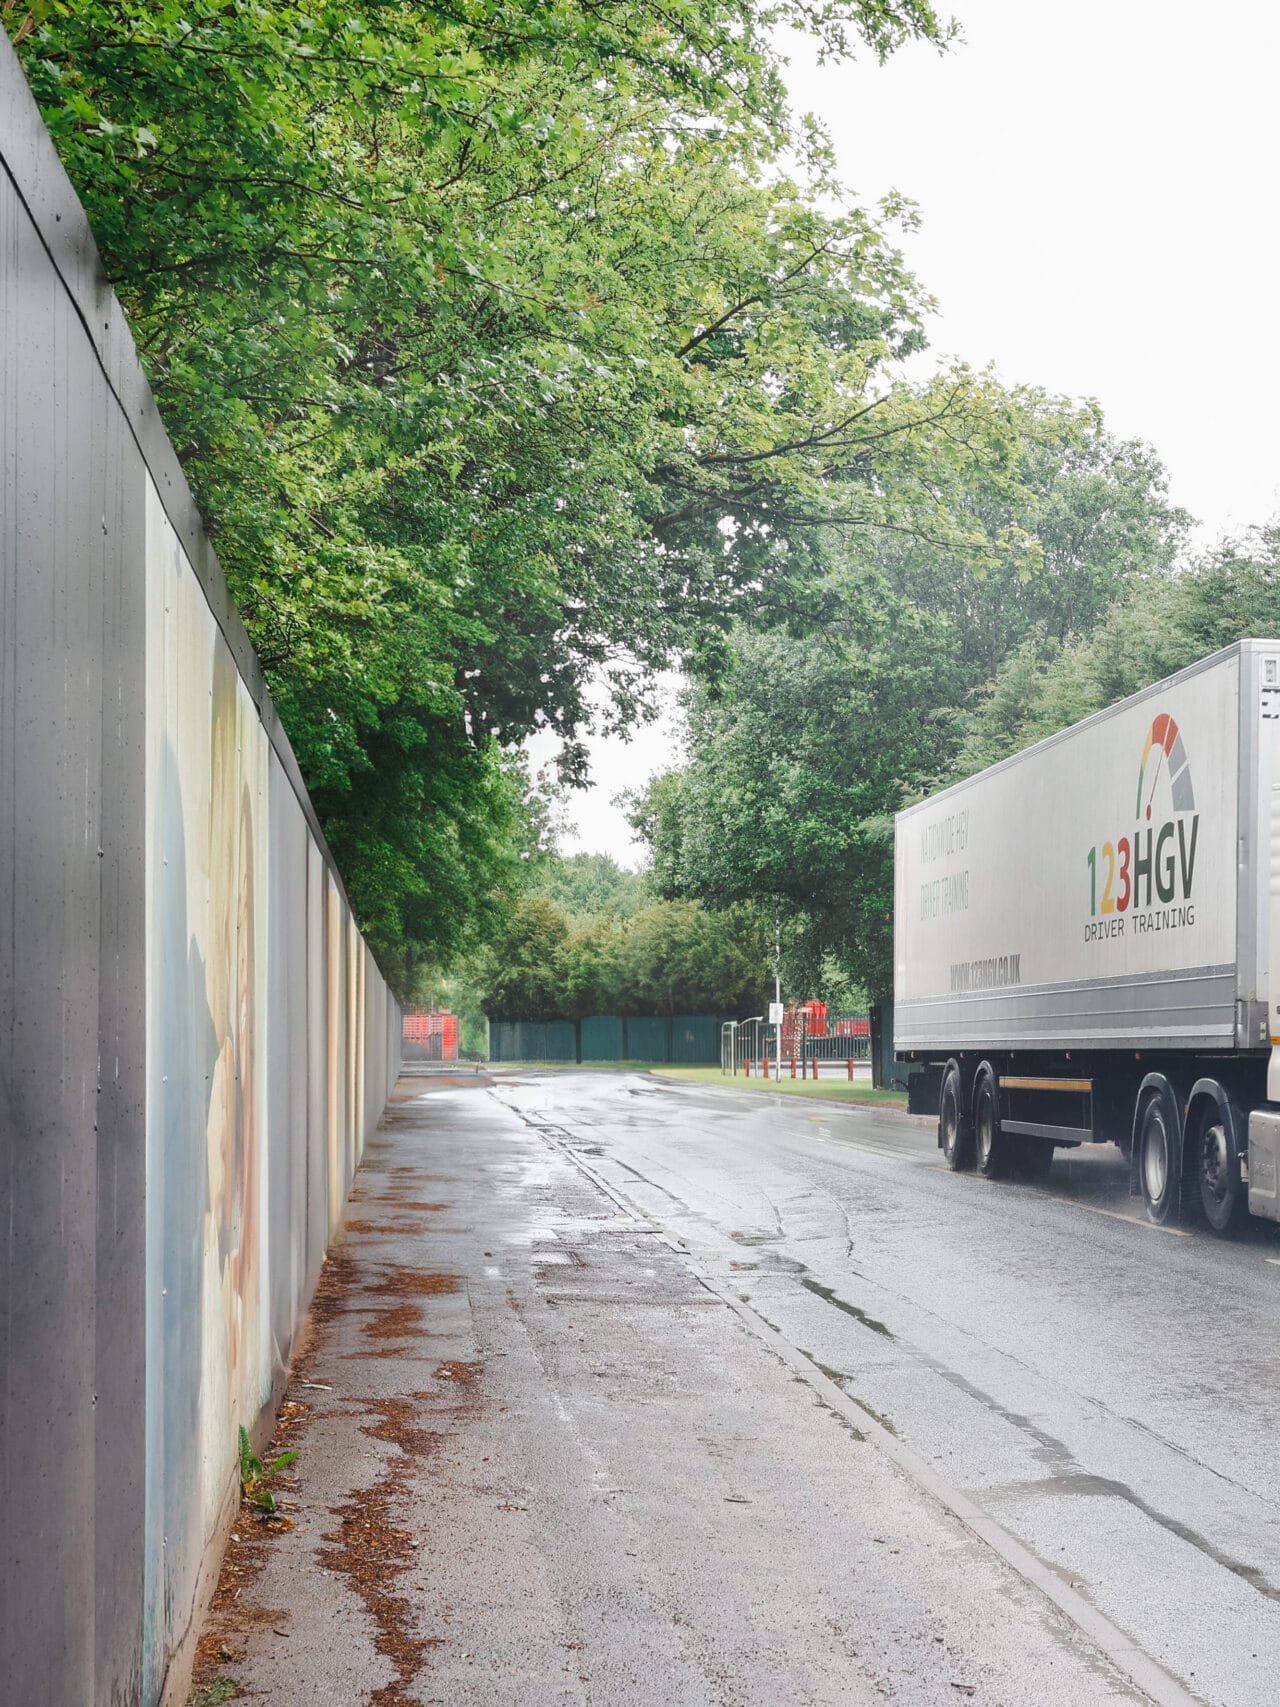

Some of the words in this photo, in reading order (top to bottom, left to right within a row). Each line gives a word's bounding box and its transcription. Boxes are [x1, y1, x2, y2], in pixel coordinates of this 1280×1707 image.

[1087, 814, 1200, 917] 123HGV
[1084, 918, 1125, 942] DRIVER
[1132, 905, 1195, 935] TRAINING
